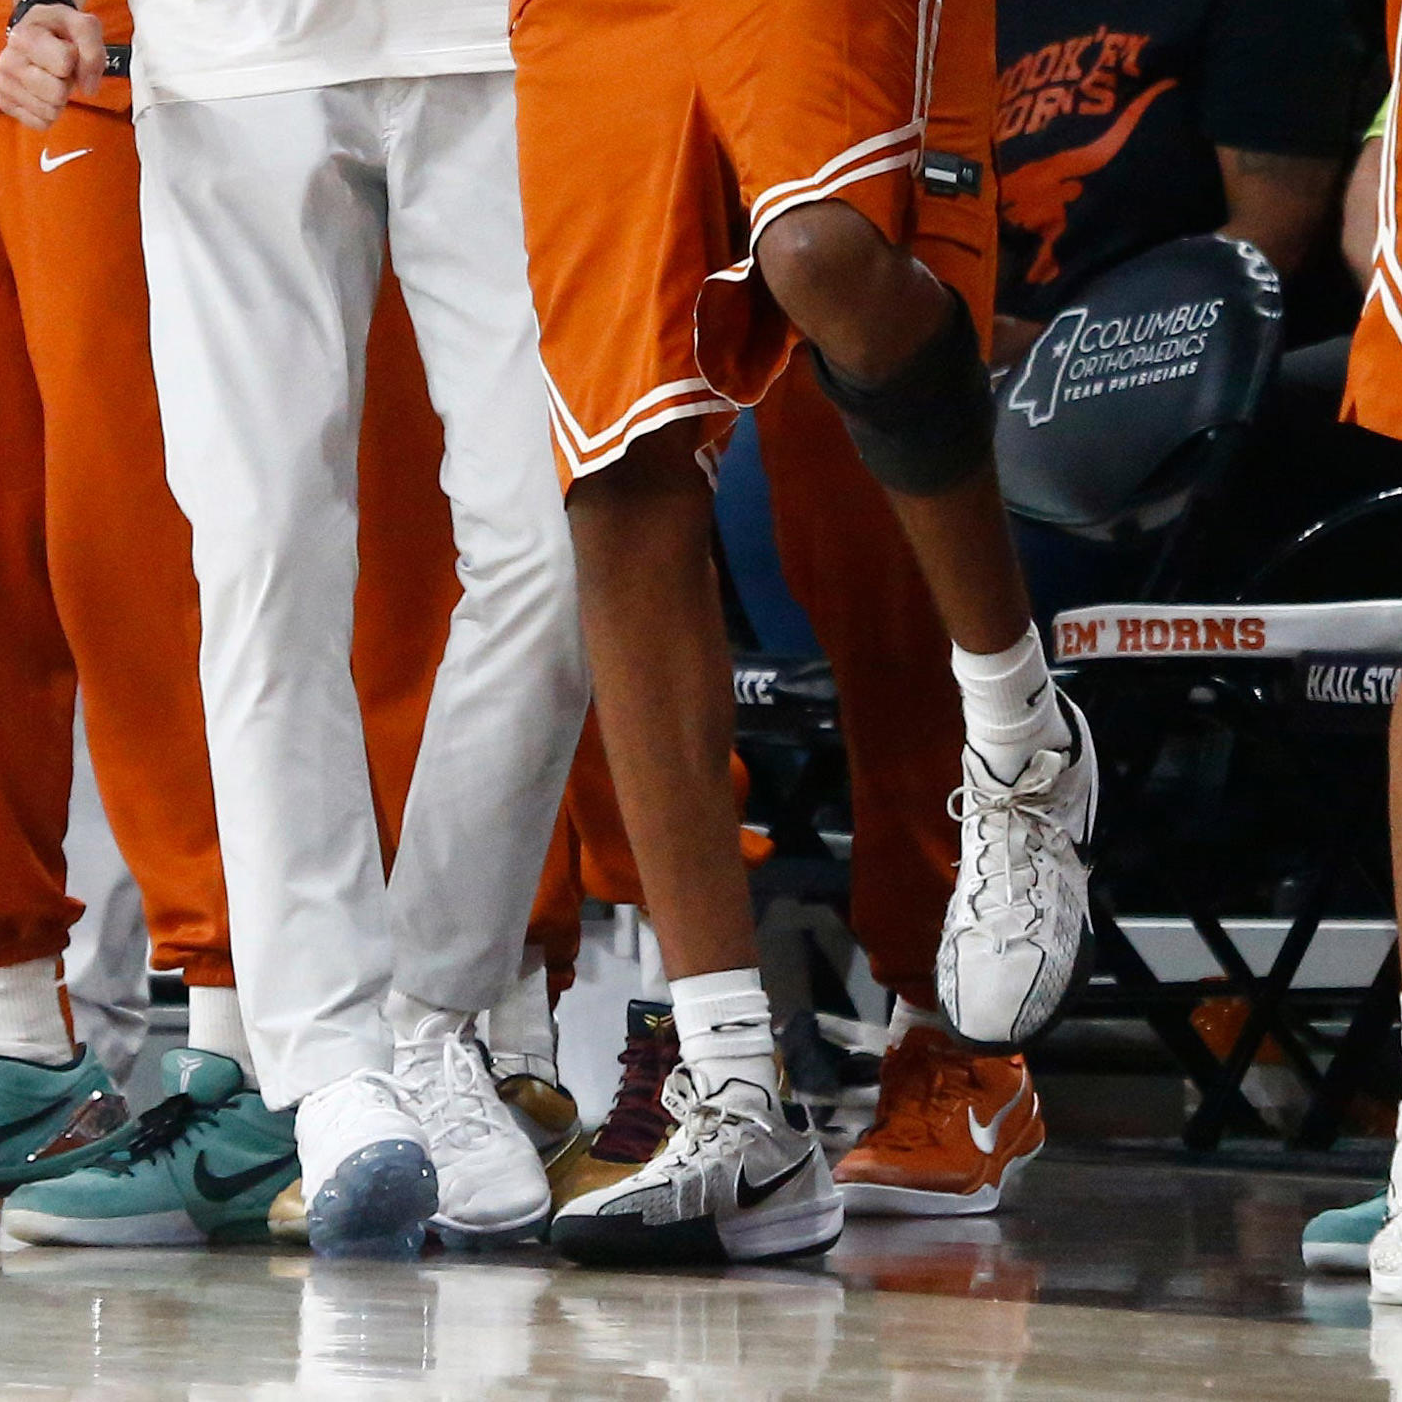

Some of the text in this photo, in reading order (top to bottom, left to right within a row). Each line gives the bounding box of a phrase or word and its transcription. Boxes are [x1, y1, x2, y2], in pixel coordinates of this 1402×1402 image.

[994, 67, 1117, 144] ORNS
[1078, 300, 1225, 355] COLUMBUS
[1068, 333, 1208, 382] ORTHOPAEDICS
[1108, 361, 1199, 392] PHYSICIANS
[1063, 381, 1103, 402] TEAM
[1115, 617, 1266, 653] HORNS
[1306, 664, 1363, 704] HAIL
